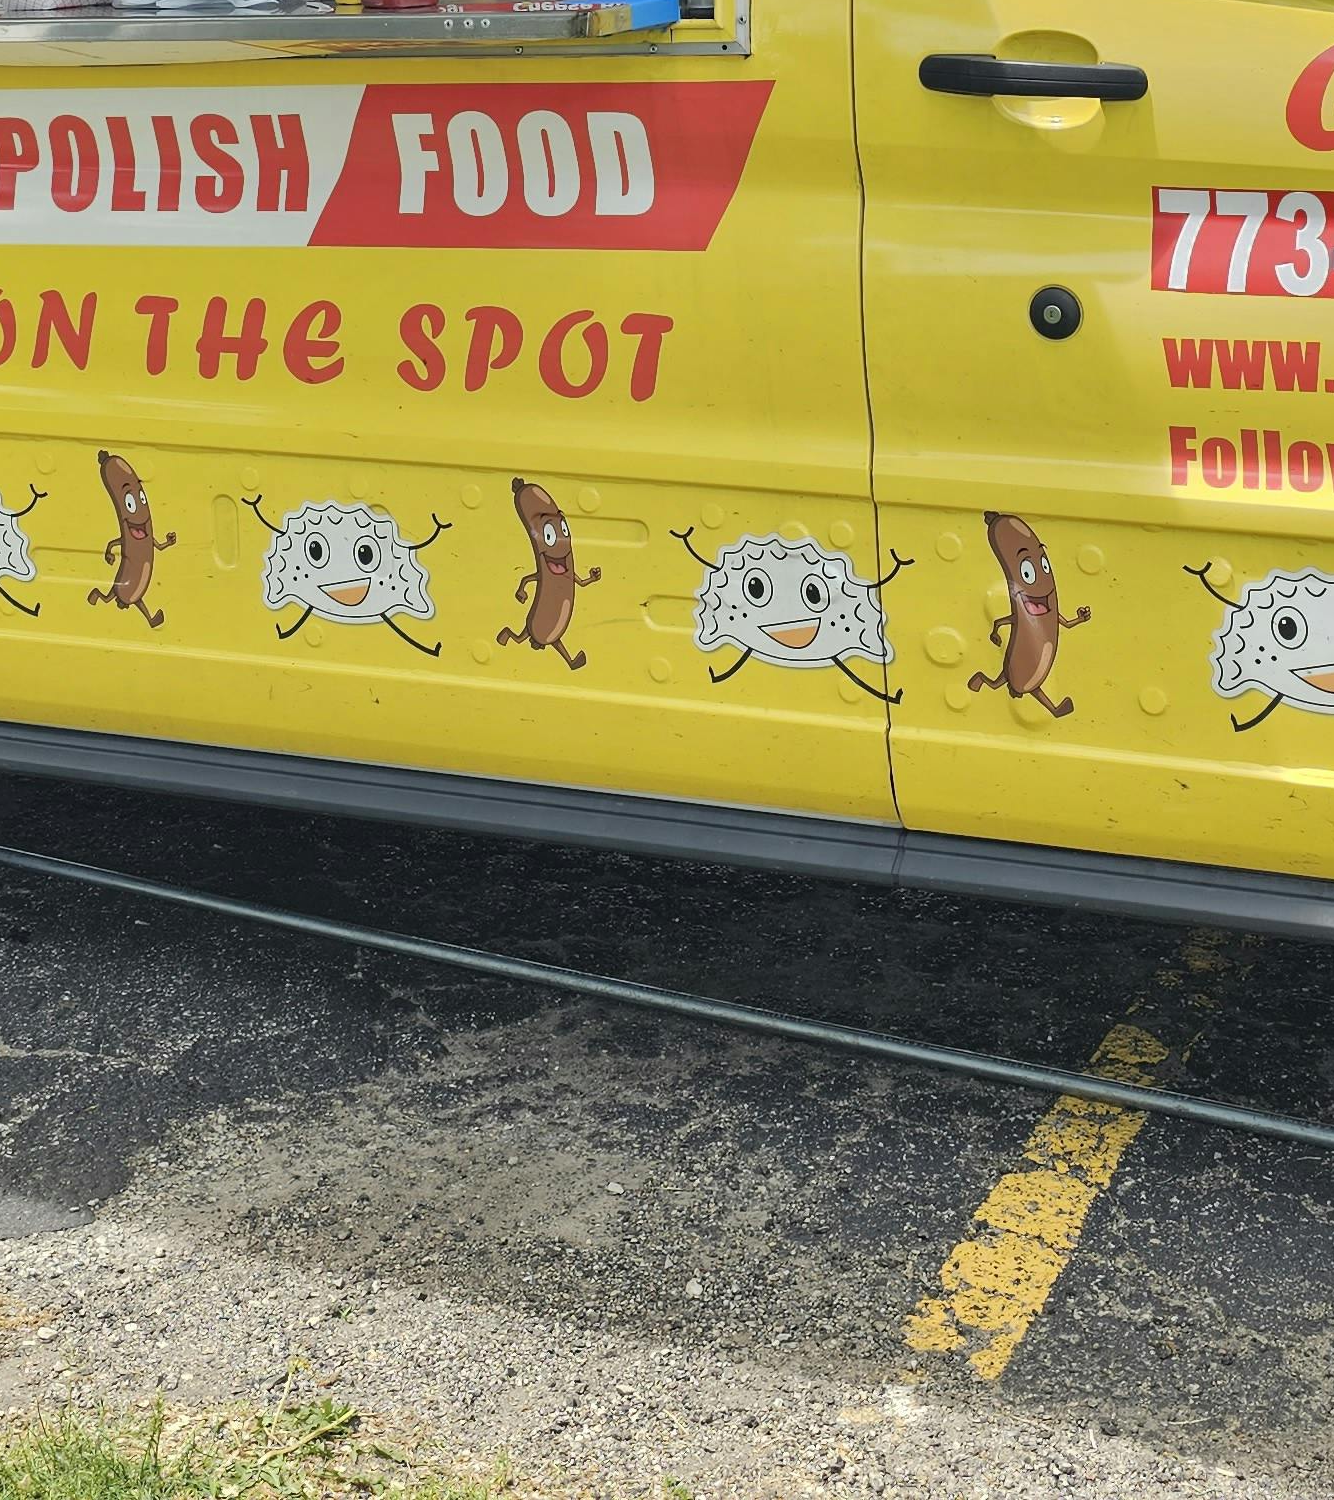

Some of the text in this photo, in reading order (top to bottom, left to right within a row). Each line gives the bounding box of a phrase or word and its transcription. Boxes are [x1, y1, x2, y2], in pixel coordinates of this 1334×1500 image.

[392, 110, 655, 216] FOOD
[134, 295, 346, 385] THE
[396, 302, 673, 402] SPOT
